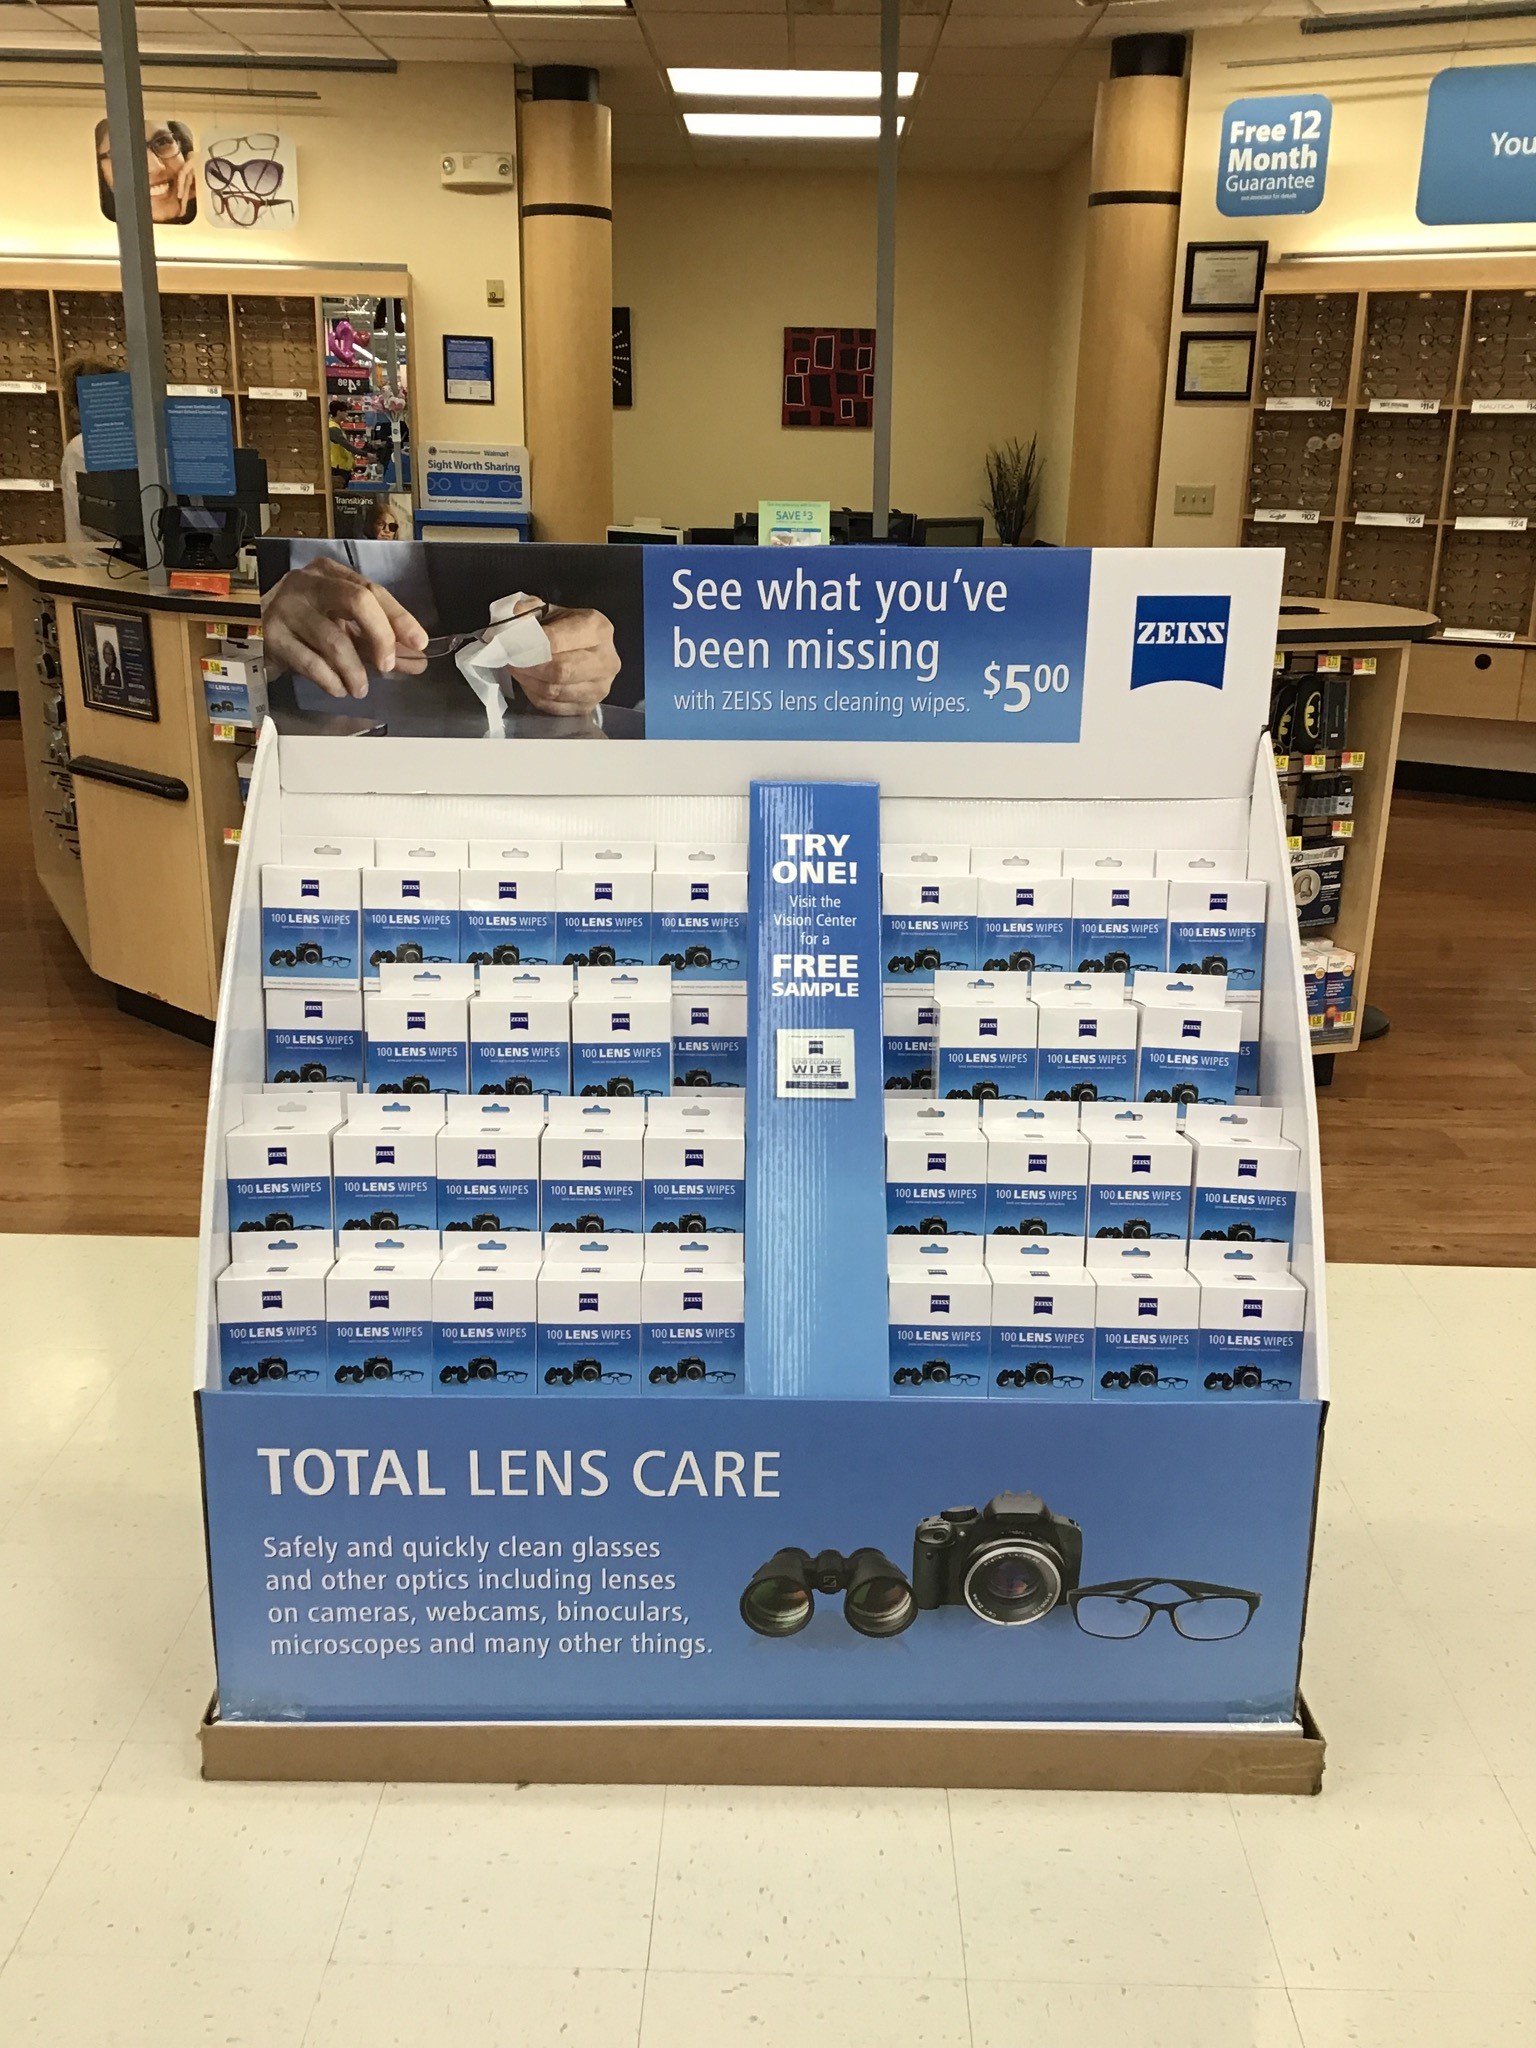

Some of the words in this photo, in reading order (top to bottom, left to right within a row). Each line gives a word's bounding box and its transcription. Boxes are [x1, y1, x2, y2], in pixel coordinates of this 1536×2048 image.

[1230, 121, 1287, 144] Free
[1289, 109, 1322, 140] 12
[1227, 143, 1318, 173] Month
[1225, 173, 1316, 192] Guarantee
[1316, 399, 1331, 407] $102
[1421, 402, 1435, 410] $114
[428, 460, 452, 471] Sight
[453, 460, 483, 470] Worth
[484, 461, 520, 473] Sharing
[334, 496, 374, 505] Transitions
[776, 510, 801, 520] SAVE
[672, 568, 742, 611] See
[756, 568, 862, 612] what
[876, 568, 1008, 623] you've
[1137, 621, 1228, 645] ZEISS
[673, 626, 769, 669] been
[787, 628, 940, 683] missing
[673, 690, 715, 711] with
[722, 690, 773, 711] ZEISS
[780, 689, 817, 711] lens
[823, 689, 904, 718] cleaning
[911, 692, 970, 718] wipes.
[780, 833, 851, 857] TRY
[772, 861, 858, 885] ONE!
[789, 894, 817, 909] Visit
[821, 894, 841, 908] the
[272, 913, 287, 923] 100
[289, 913, 320, 924] LENS
[322, 915, 351, 925] WIPES
[566, 917, 580, 927] 100
[582, 917, 613, 927] LENS
[615, 917, 643, 927] WIPES
[662, 917, 677, 927] 100
[678, 917, 709, 927] LENS
[712, 917, 739, 927] WIPES
[773, 914, 812, 928] Vision
[815, 914, 857, 928] Center
[892, 920, 906, 930] 100
[908, 920, 939, 931] LENS
[942, 921, 969, 931] WIPES
[1082, 923, 1097, 933] 100
[1099, 923, 1129, 933] LENS
[1132, 923, 1159, 934] WIPES
[800, 931, 819, 946] for
[822, 935, 830, 946] a
[772, 953, 859, 979] FREE
[771, 981, 860, 998] SAMPLE
[276, 1034, 291, 1044] 100
[293, 1034, 324, 1045] LENS
[326, 1035, 354, 1045] WIPES
[378, 1047, 393, 1057] 100
[395, 1047, 427, 1057] LENS
[429, 1046, 458, 1057] WIPES
[949, 1053, 964, 1063] 100
[966, 1053, 997, 1063] LENS
[1000, 1053, 1028, 1063] WIPES
[793, 1064, 842, 1074] WIPE
[345, 1181, 361, 1192] 100
[363, 1181, 396, 1192] LENS
[398, 1181, 428, 1192] WIPES
[552, 1185, 567, 1195] 100
[569, 1185, 602, 1196] LENS
[604, 1185, 633, 1196] WIPES
[896, 1188, 911, 1198] 100
[914, 1188, 946, 1199] LENS
[948, 1189, 977, 1199] WIPES
[1100, 1189, 1116, 1200] 100
[1118, 1190, 1150, 1201] LENS
[1152, 1190, 1182, 1201] WIPES
[230, 1328, 247, 1339] 100
[250, 1326, 284, 1338] LENS
[286, 1325, 317, 1337] WIPES
[548, 1329, 563, 1340] 100
[566, 1329, 599, 1340] LENS
[602, 1329, 632, 1340] WIPES
[898, 1330, 914, 1340] 100
[916, 1330, 949, 1341] LENS
[952, 1331, 981, 1341] WIPES
[1210, 1334, 1226, 1345] 100
[1228, 1335, 1261, 1346] LENS
[1264, 1336, 1294, 1347] WIPES
[256, 1447, 447, 1496] TOTAL
[469, 1449, 609, 1497] LENS
[632, 1449, 781, 1498] CARE
[263, 1536, 338, 1564] Safely
[346, 1536, 393, 1558] and
[402, 1536, 490, 1564] quickly
[498, 1536, 562, 1558] clean
[572, 1536, 661, 1564] glasses
[265, 1568, 312, 1591] and
[321, 1568, 387, 1591] other
[395, 1569, 469, 1596] optics
[478, 1567, 592, 1596] including
[601, 1567, 676, 1590] lenses
[268, 1605, 298, 1624] on
[307, 1604, 417, 1627] cameras,
[425, 1599, 547, 1626] webcams,
[557, 1599, 690, 1626] binoculars,
[270, 1633, 422, 1661] microscopes
[429, 1632, 475, 1655] and
[485, 1636, 550, 1661] many
[558, 1631, 623, 1654] other
[630, 1631, 713, 1659] things.
